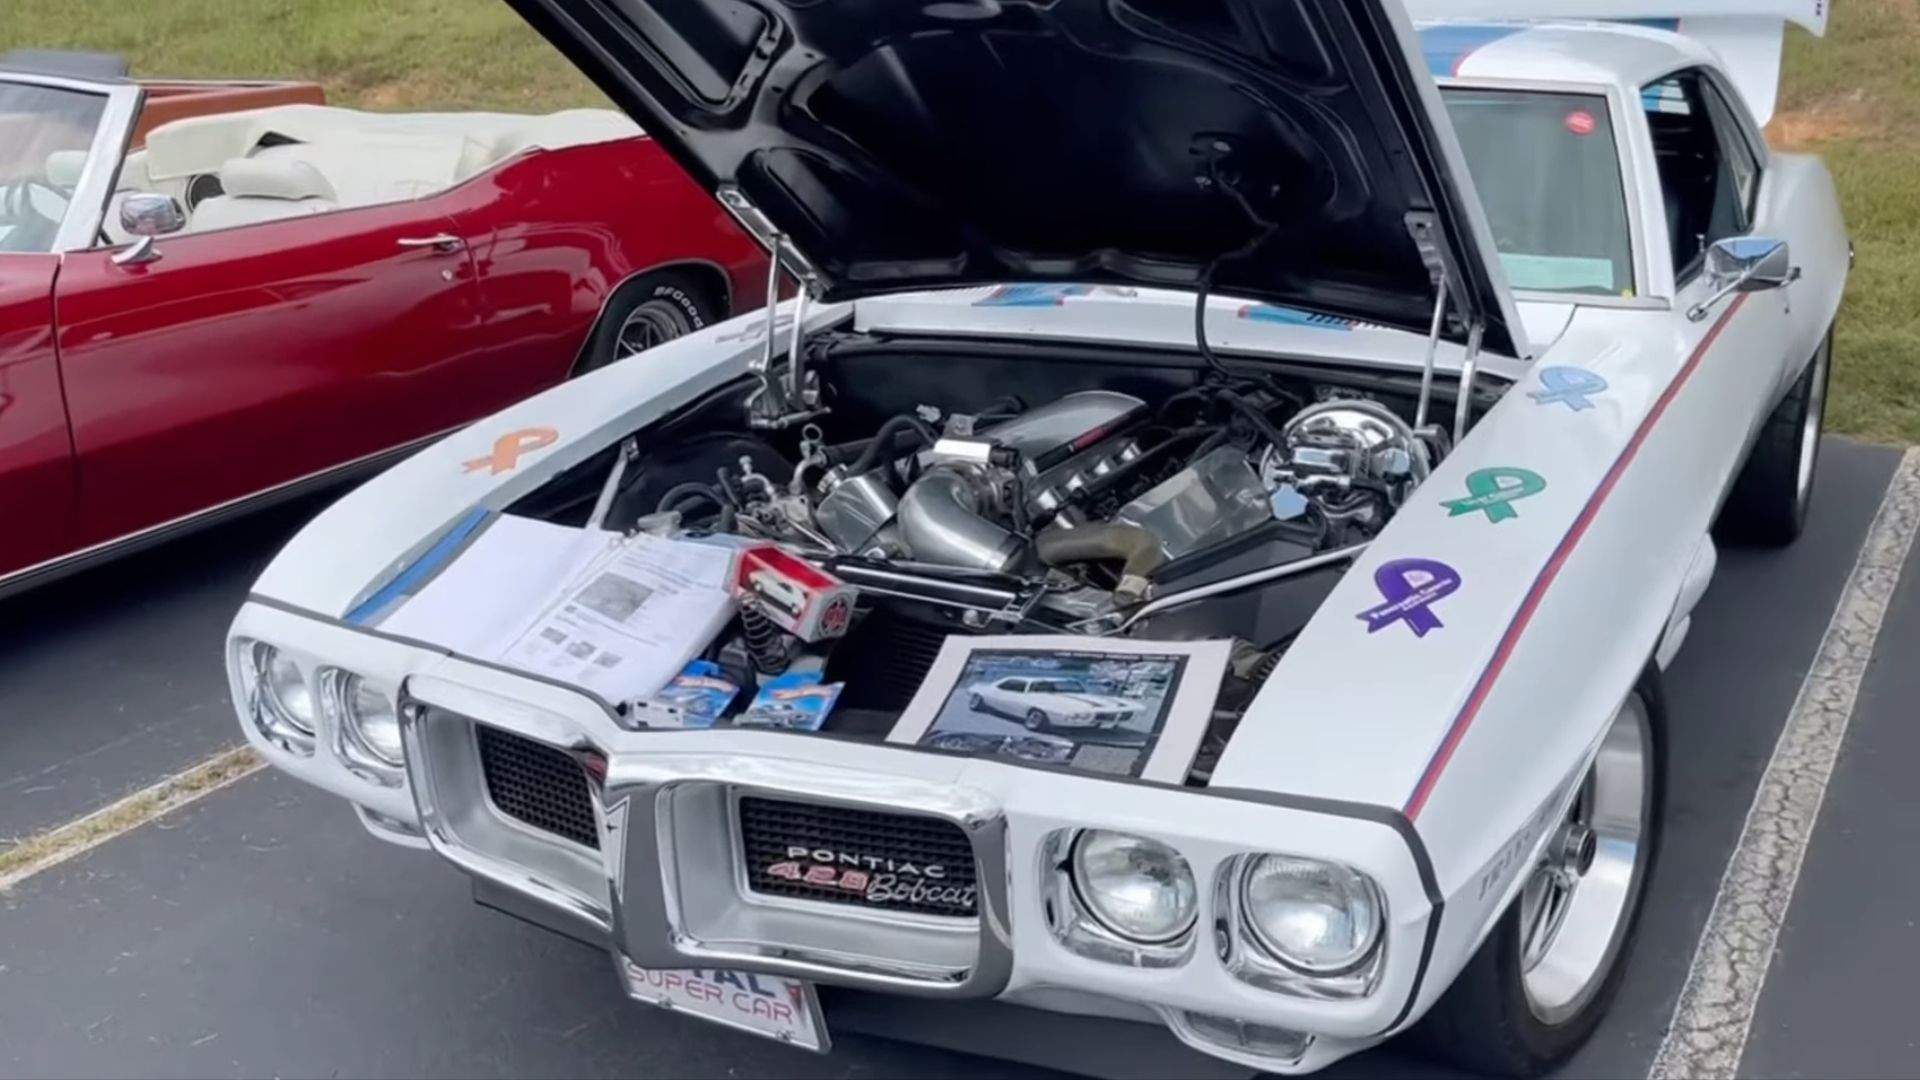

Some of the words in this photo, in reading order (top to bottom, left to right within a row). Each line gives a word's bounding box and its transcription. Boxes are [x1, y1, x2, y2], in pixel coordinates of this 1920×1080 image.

[787, 846, 945, 878] PONTIAC
[866, 873, 977, 906] Bobcat
[628, 964, 724, 1004] SUPER
[733, 992, 793, 1025] CAR
